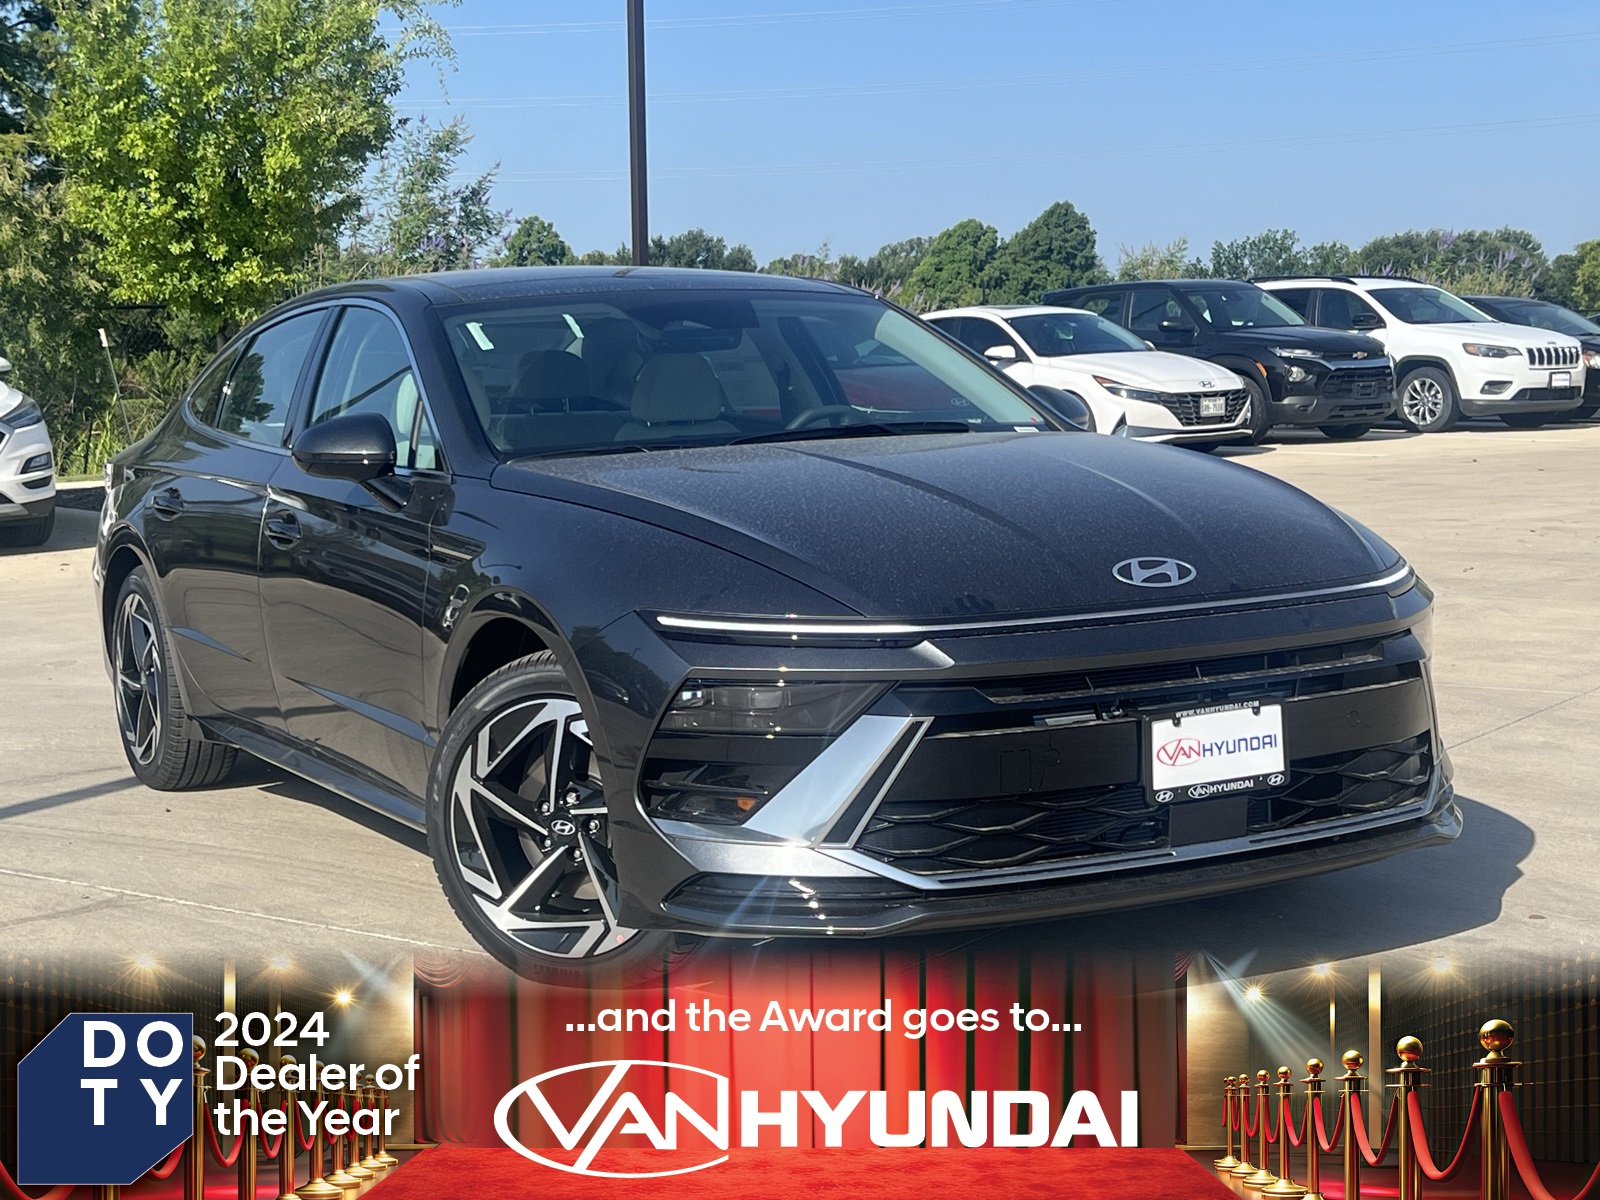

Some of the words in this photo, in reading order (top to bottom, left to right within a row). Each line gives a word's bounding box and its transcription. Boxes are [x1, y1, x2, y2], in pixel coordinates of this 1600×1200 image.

[1175, 700, 1260, 718] WWW.VANHYUNDAI.COM
[1158, 738, 1201, 766] VAN
[1202, 733, 1278, 758] HYUNDAI
[1209, 778, 1254, 794] HYUNDAI
